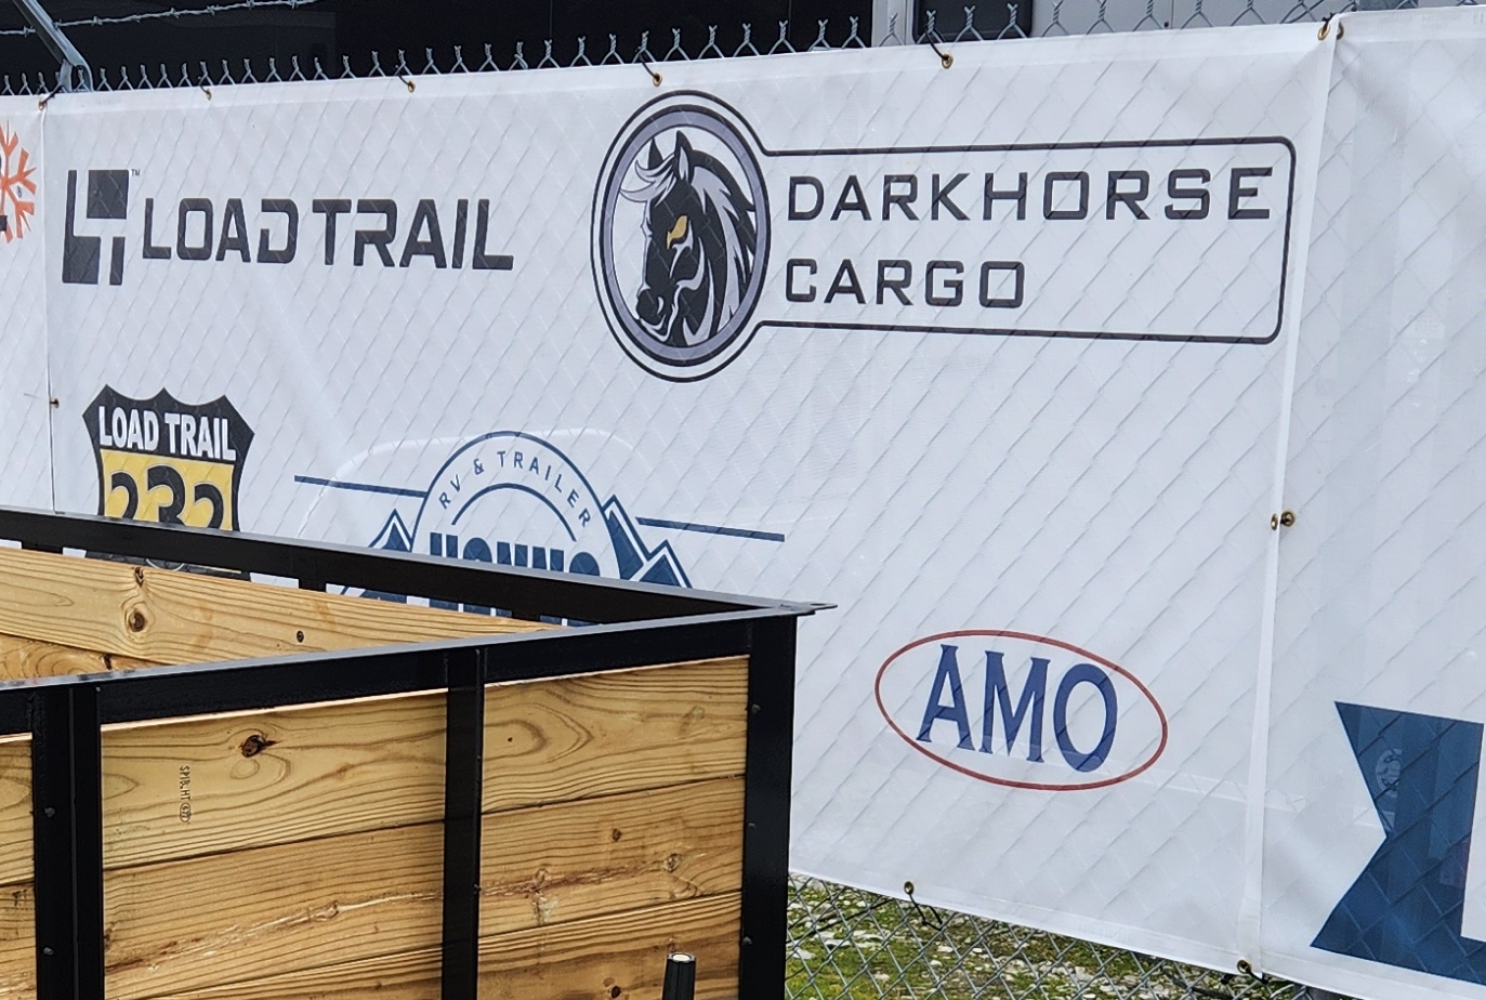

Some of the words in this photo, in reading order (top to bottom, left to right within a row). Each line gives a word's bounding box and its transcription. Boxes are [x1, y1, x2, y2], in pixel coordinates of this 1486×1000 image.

[787, 166, 1274, 221] DARKHORSE
[142, 198, 299, 264] LOAD
[312, 198, 514, 270] TRAIL
[786, 259, 1026, 309] CARGO
[98, 406, 159, 451] LOAD
[164, 412, 237, 461] TRAIL
[439, 475, 461, 510] RV
[473, 457, 485, 475] &
[497, 450, 592, 528] TRAILER
[916, 644, 1118, 773] AMO
